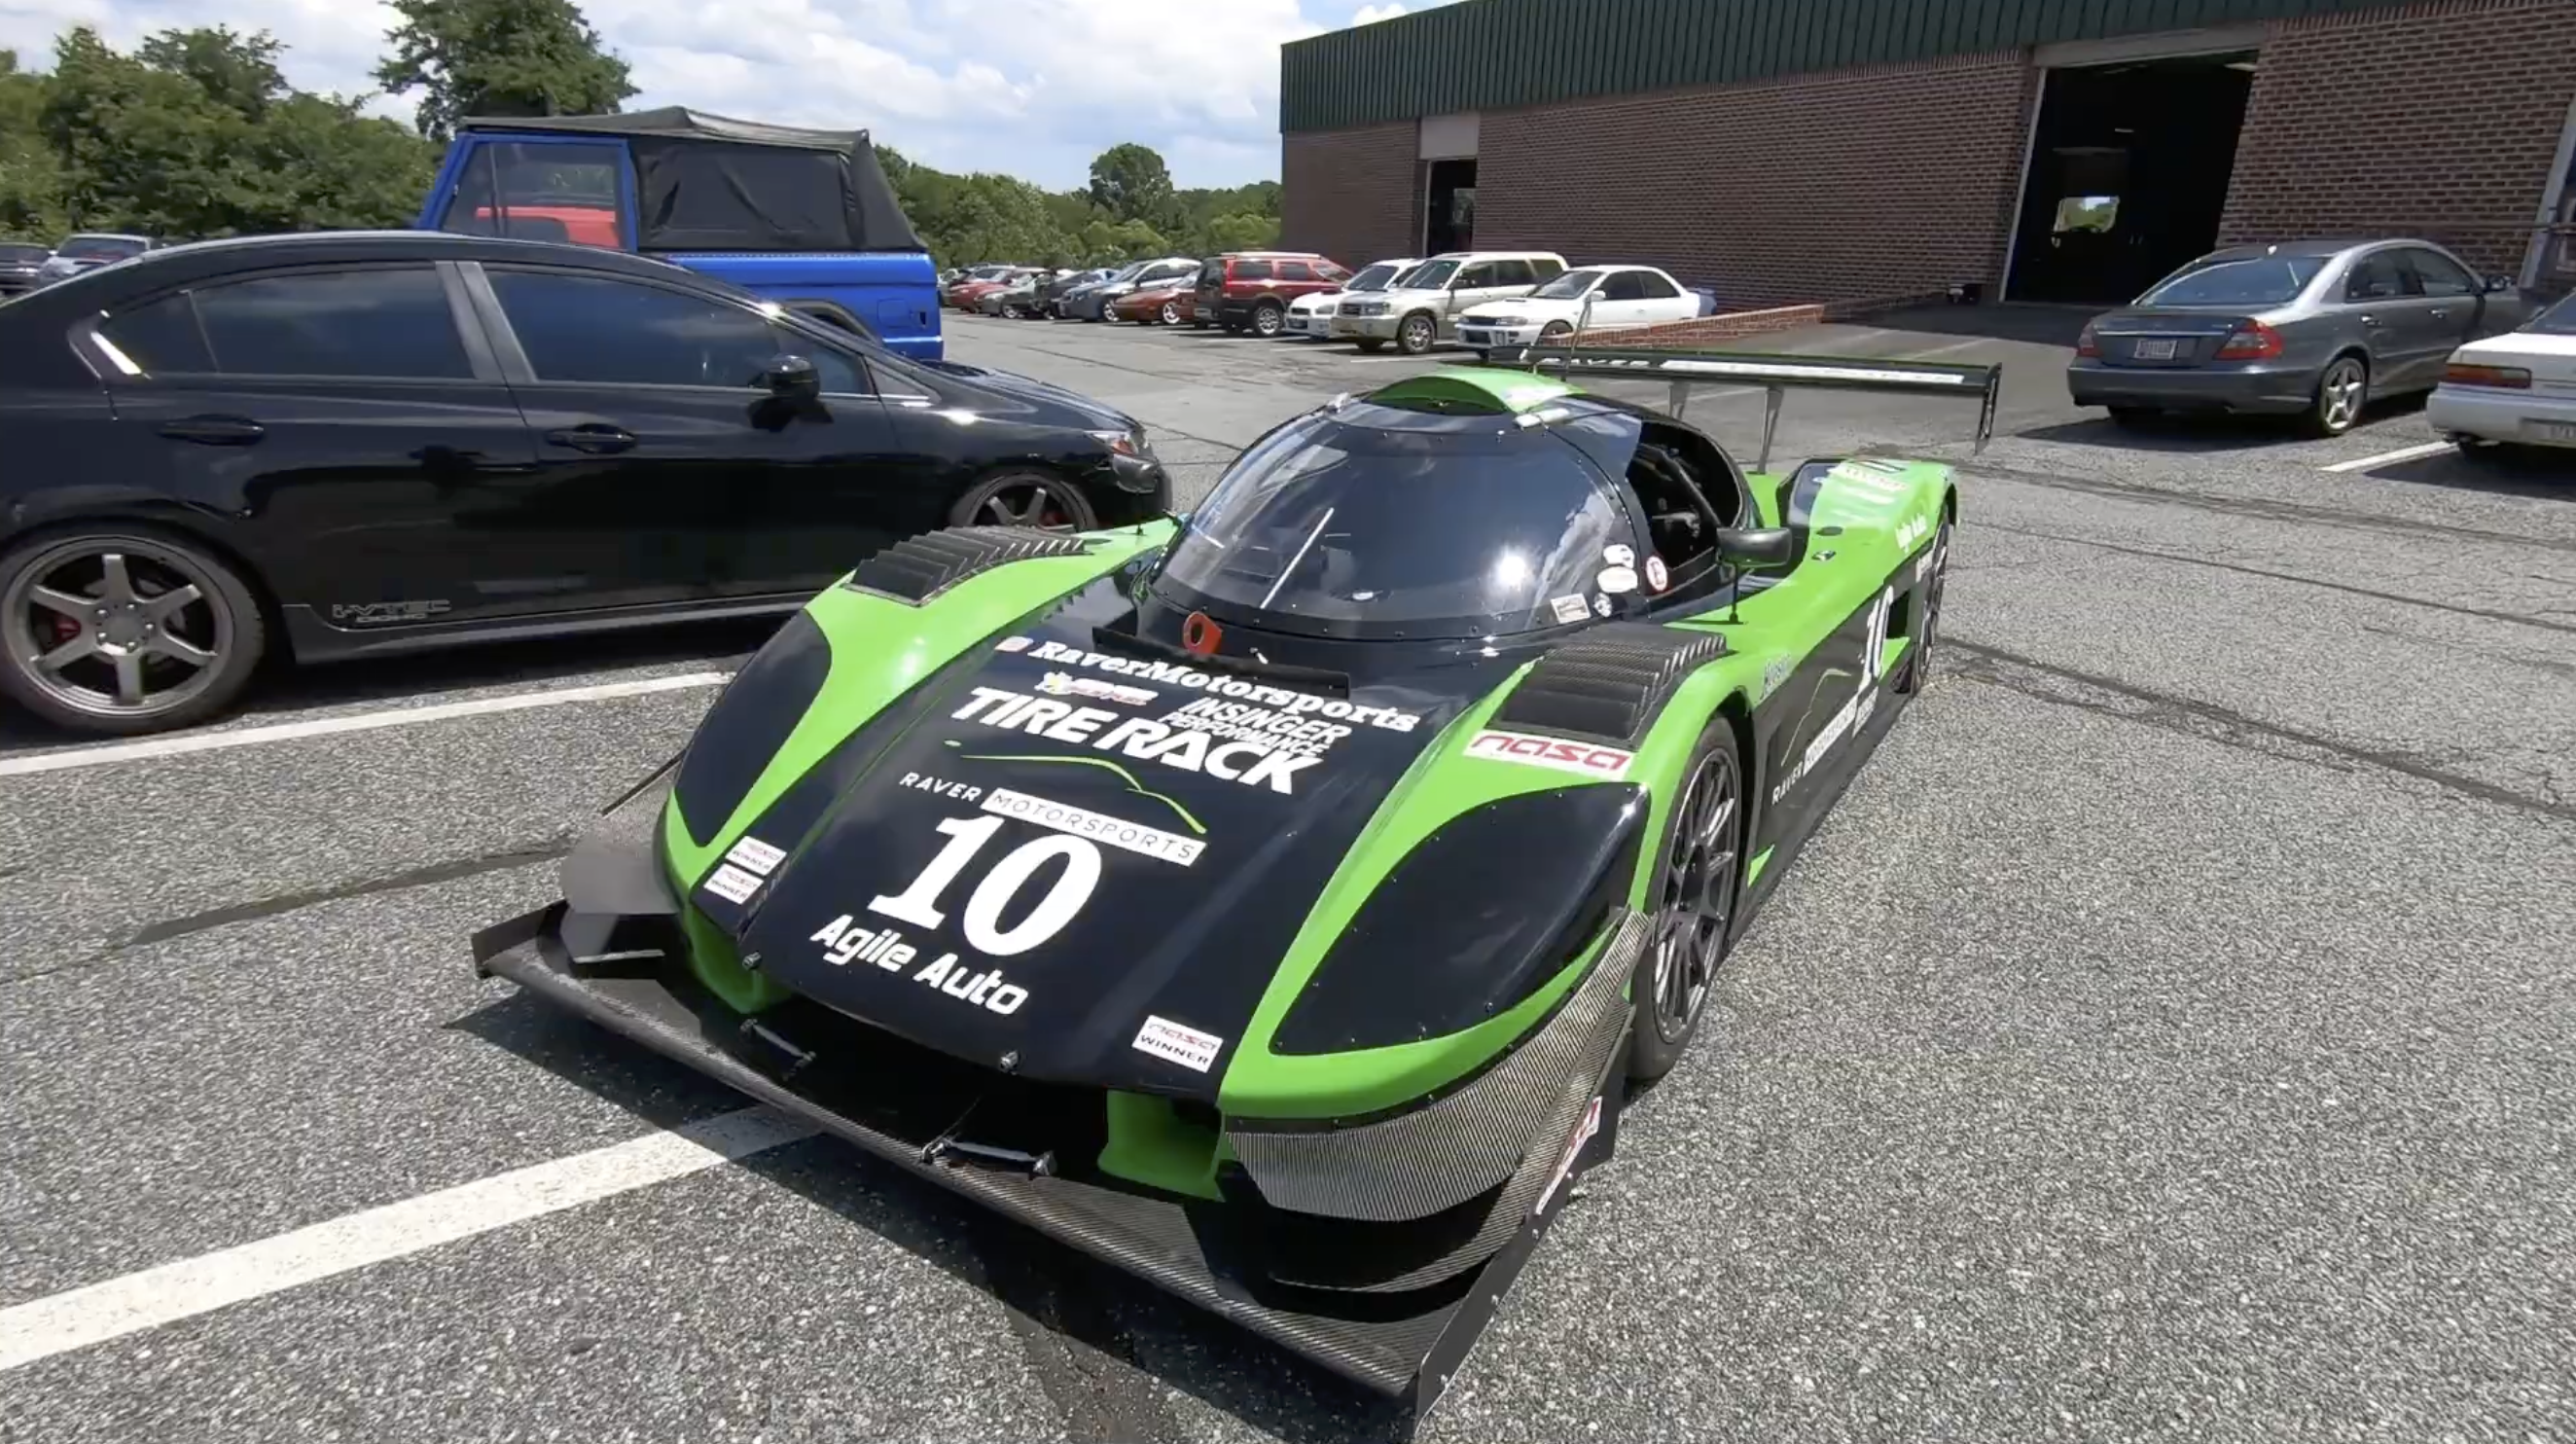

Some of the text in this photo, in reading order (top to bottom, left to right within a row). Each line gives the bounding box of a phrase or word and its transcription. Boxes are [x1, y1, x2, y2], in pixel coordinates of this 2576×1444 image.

[1027, 640, 1420, 733] RaverMotorsports
[1178, 697, 1352, 744] INSINGER
[950, 686, 1119, 744] TIRE
[1092, 717, 1324, 795] RACK
[1158, 711, 1330, 757] PERFORMANCE
[898, 772, 1196, 860] RAVER MOTORSPORTS
[868, 814, 1102, 957] 10
[810, 915, 1029, 1015] Agile Auto
[1139, 1034, 1209, 1066] WINNER
